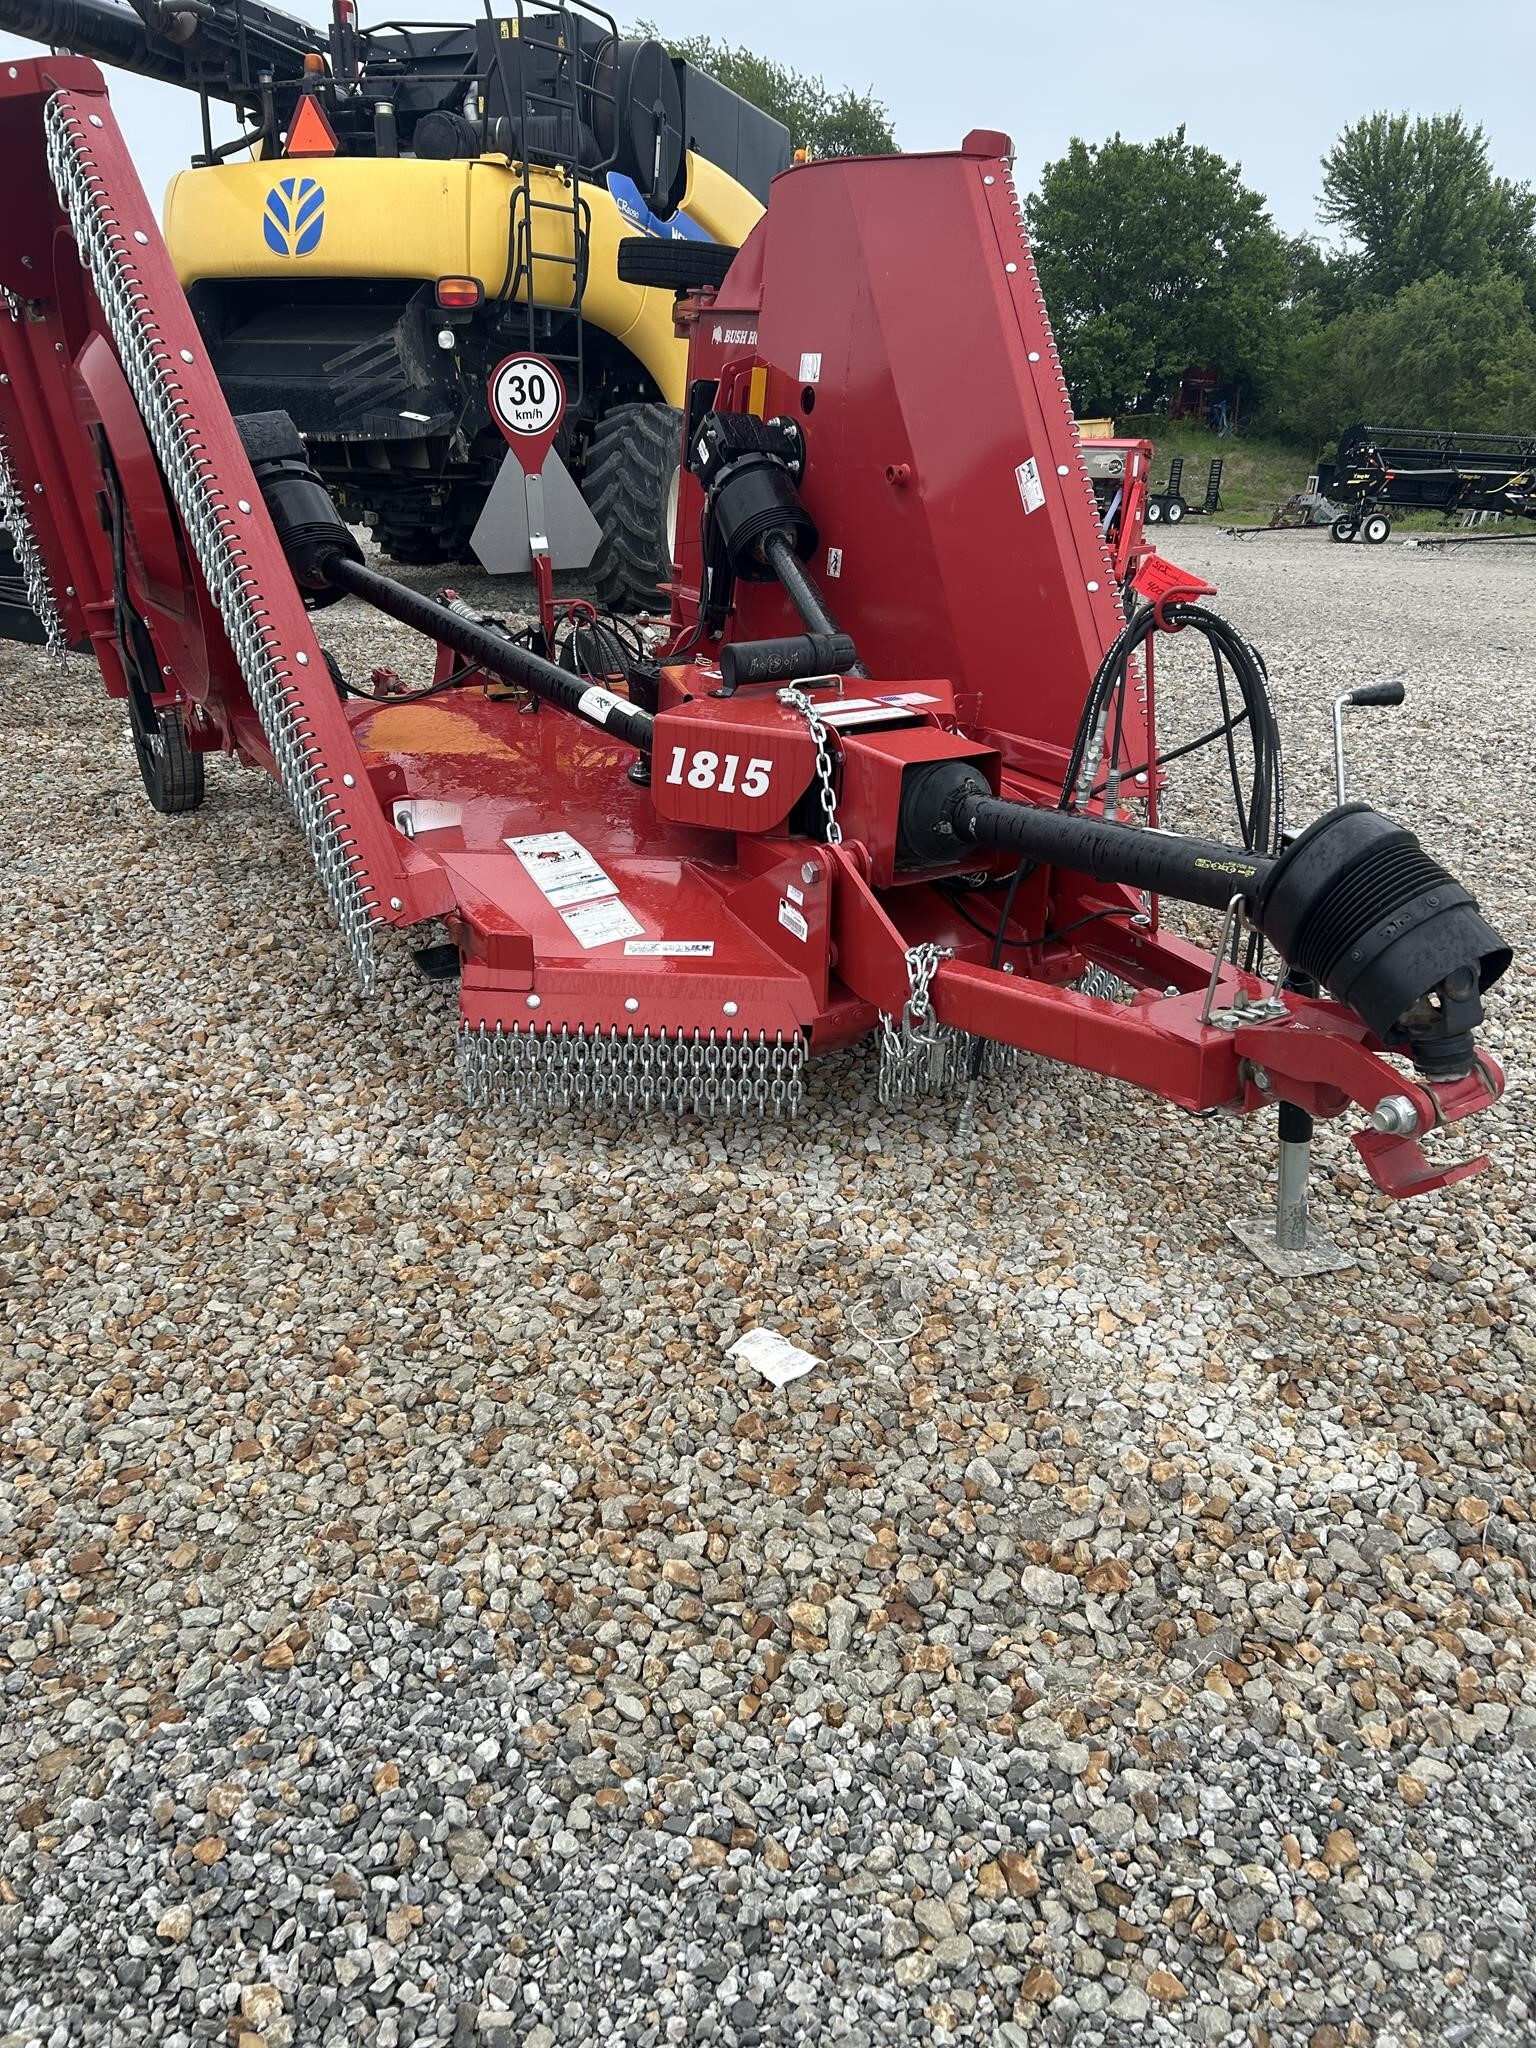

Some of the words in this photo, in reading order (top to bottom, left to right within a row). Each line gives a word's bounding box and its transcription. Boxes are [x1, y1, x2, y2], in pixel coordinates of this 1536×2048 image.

[724, 329, 748, 344] BUSH
[508, 375, 546, 405] 30
[515, 408, 543, 420] km/h
[665, 746, 773, 798] 1815
